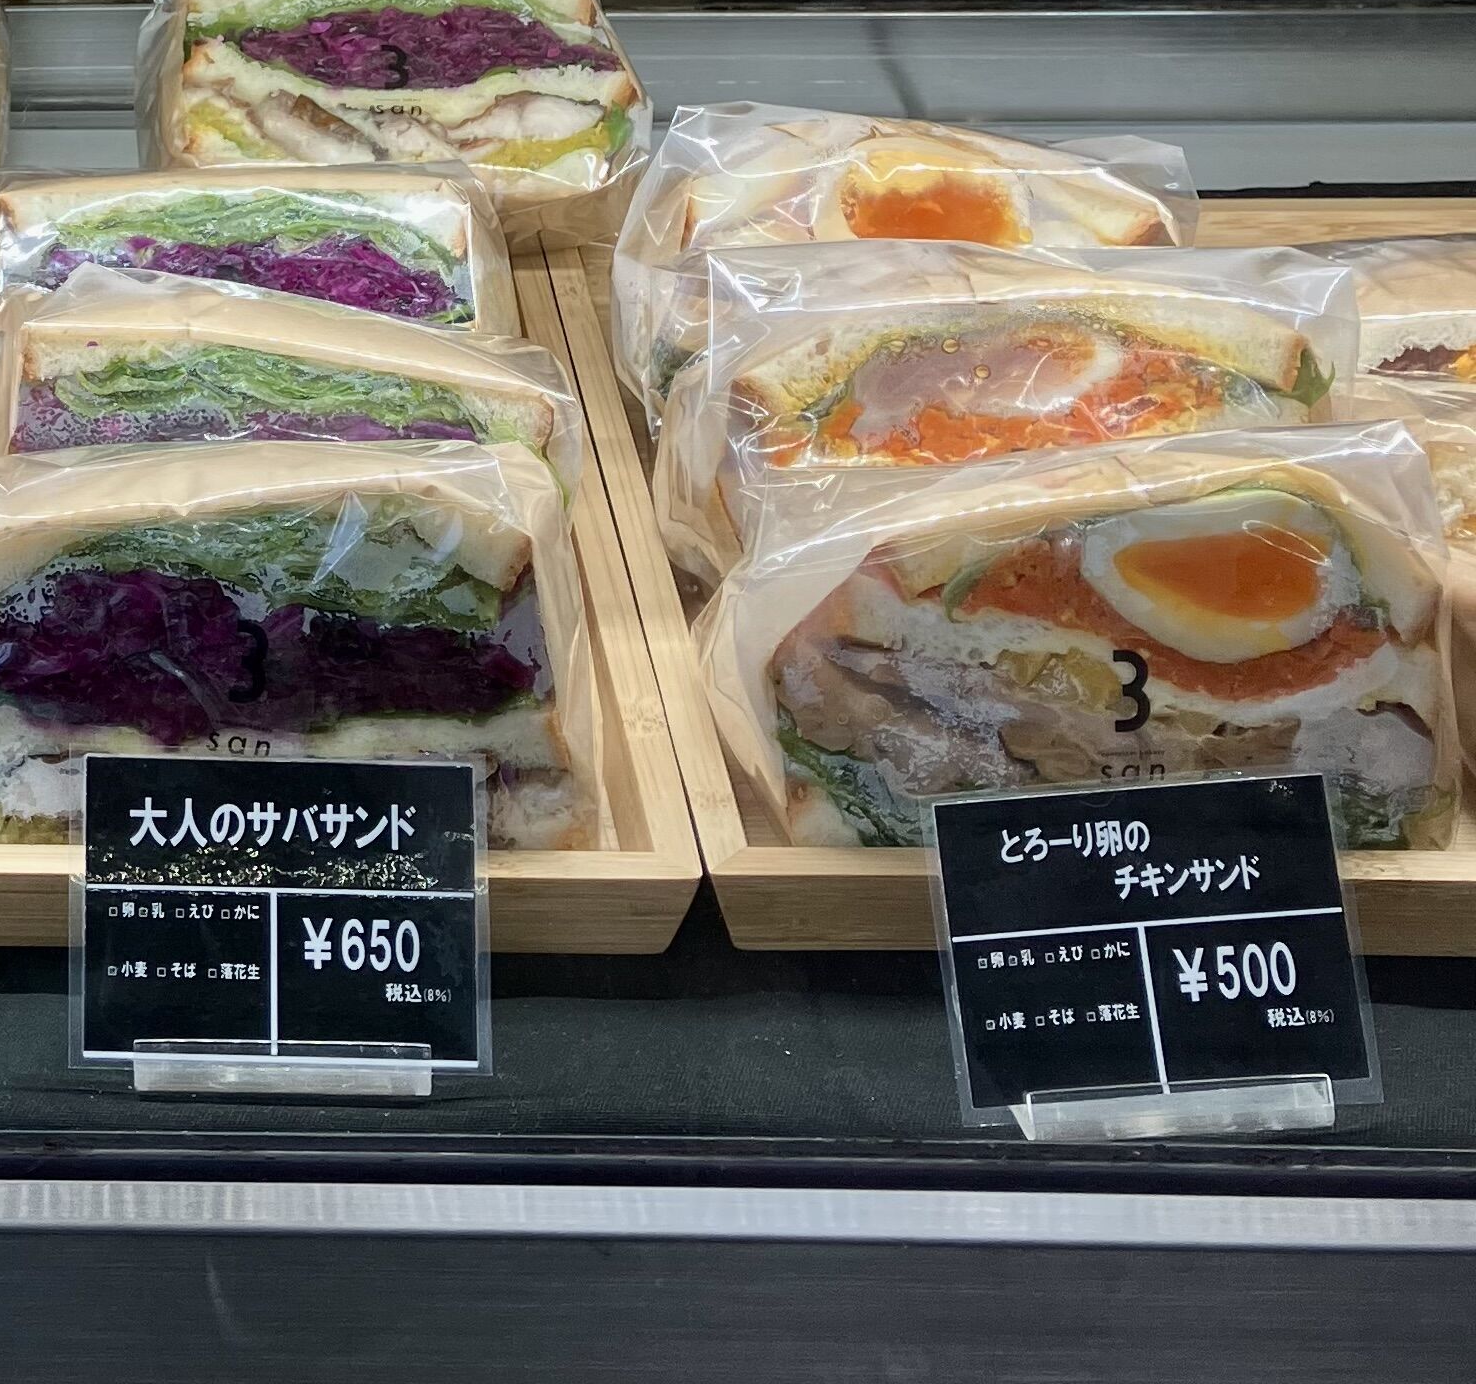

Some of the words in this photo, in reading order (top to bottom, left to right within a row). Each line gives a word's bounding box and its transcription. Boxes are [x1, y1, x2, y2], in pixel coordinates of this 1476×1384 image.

[380, 44, 409, 89] 3
[373, 104, 422, 115] san
[228, 619, 269, 703] 3
[1113, 649, 1151, 733] 3
[206, 731, 271, 757] san
[128, 796, 416, 851] 大人のサバサンド
[1000, 819, 1151, 864] とろーり卵の
[1114, 854, 1261, 899] チキンサンド
[302, 916, 421, 973] ¥650
[1172, 940, 1297, 1002] ¥500
